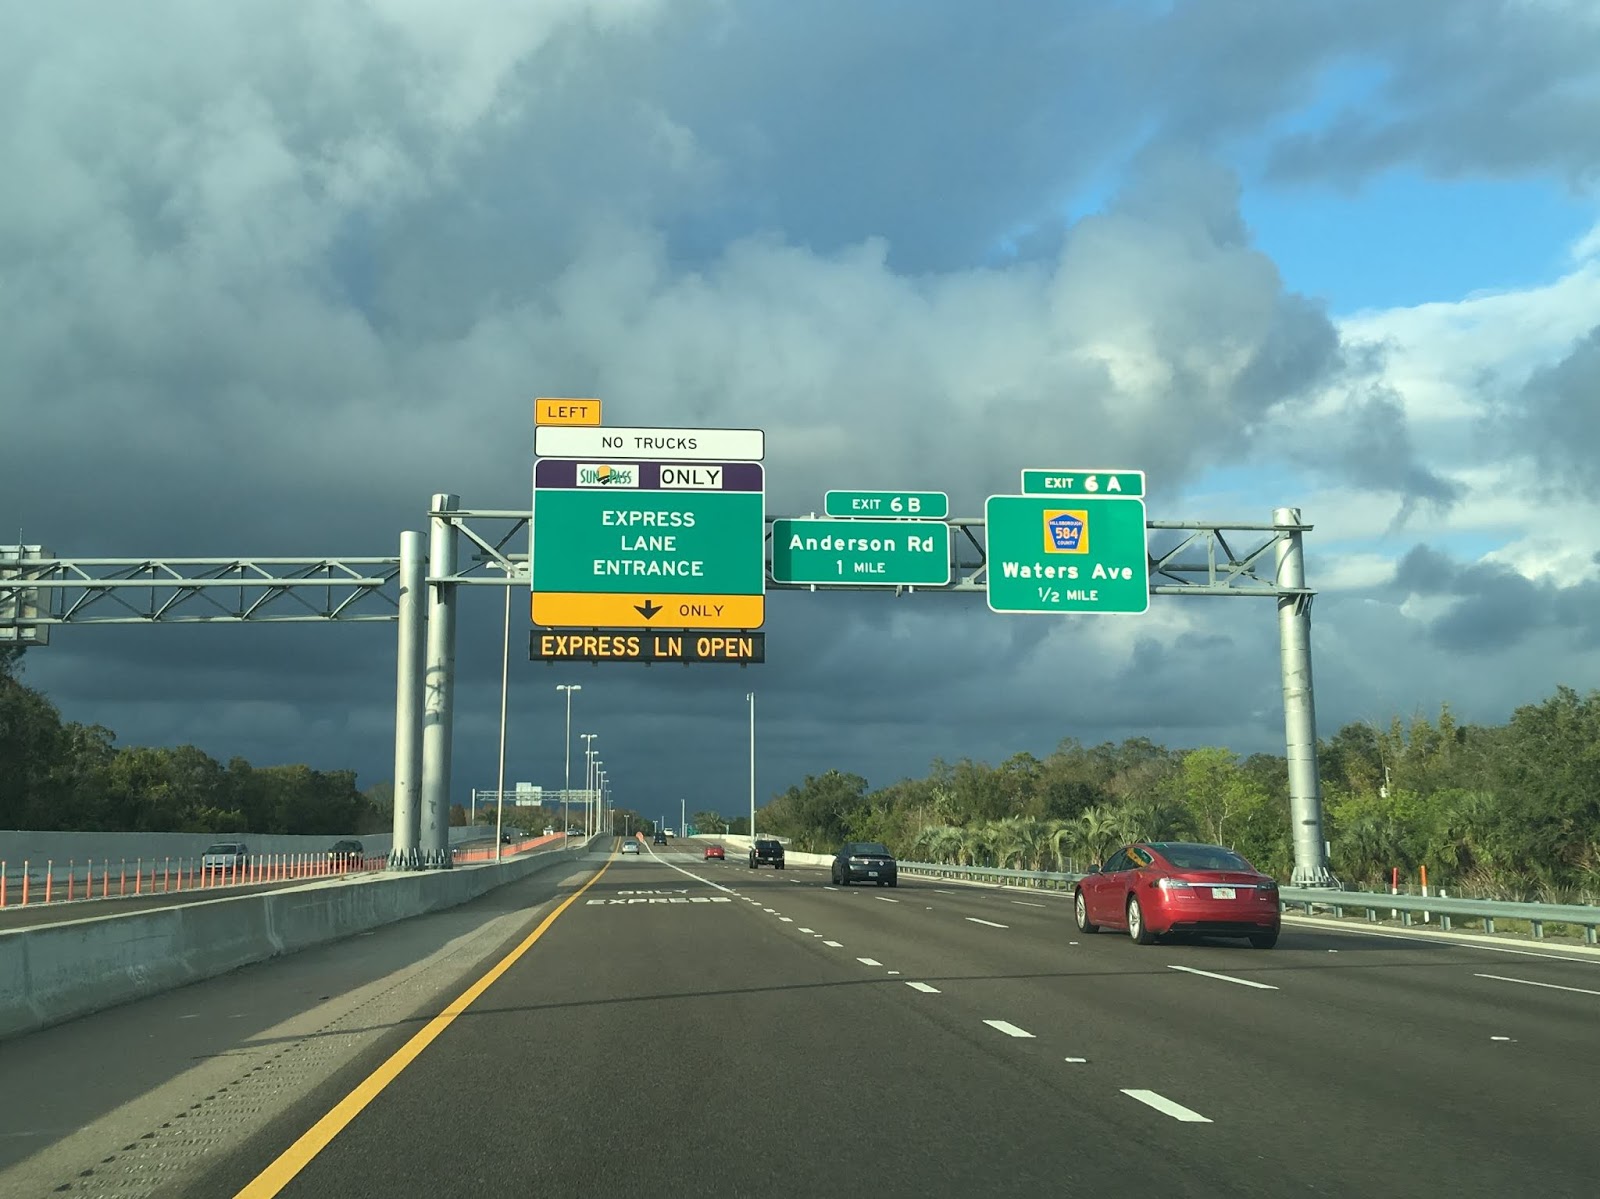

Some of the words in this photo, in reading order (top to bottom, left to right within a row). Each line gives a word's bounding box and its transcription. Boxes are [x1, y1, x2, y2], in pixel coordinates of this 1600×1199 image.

[547, 406, 588, 418] LEFT
[602, 436, 623, 449] NO
[634, 437, 698, 450] TRUCKS
[661, 469, 720, 485] ONLY
[1044, 477, 1074, 489] EXIT
[1084, 475, 1099, 492] 6
[1106, 475, 1122, 492] A
[852, 498, 882, 510] EXIT
[602, 510, 696, 527] EXPRESS
[1055, 527, 1079, 539] 584
[621, 535, 677, 552] LANE
[788, 533, 896, 552] Anderson
[907, 535, 934, 552] Rd
[593, 559, 704, 577] ENTRANCE
[836, 559, 843, 575] 1
[853, 562, 886, 574] MILE
[1002, 562, 1079, 579] Waters
[1091, 563, 1133, 580] Ave
[1066, 589, 1099, 601] MILE
[679, 604, 725, 617] ONLY
[540, 635, 641, 656] EXPRESS
[654, 636, 682, 657] LN
[697, 636, 753, 658] OPEN
[586, 897, 732, 905] EXPRESS
